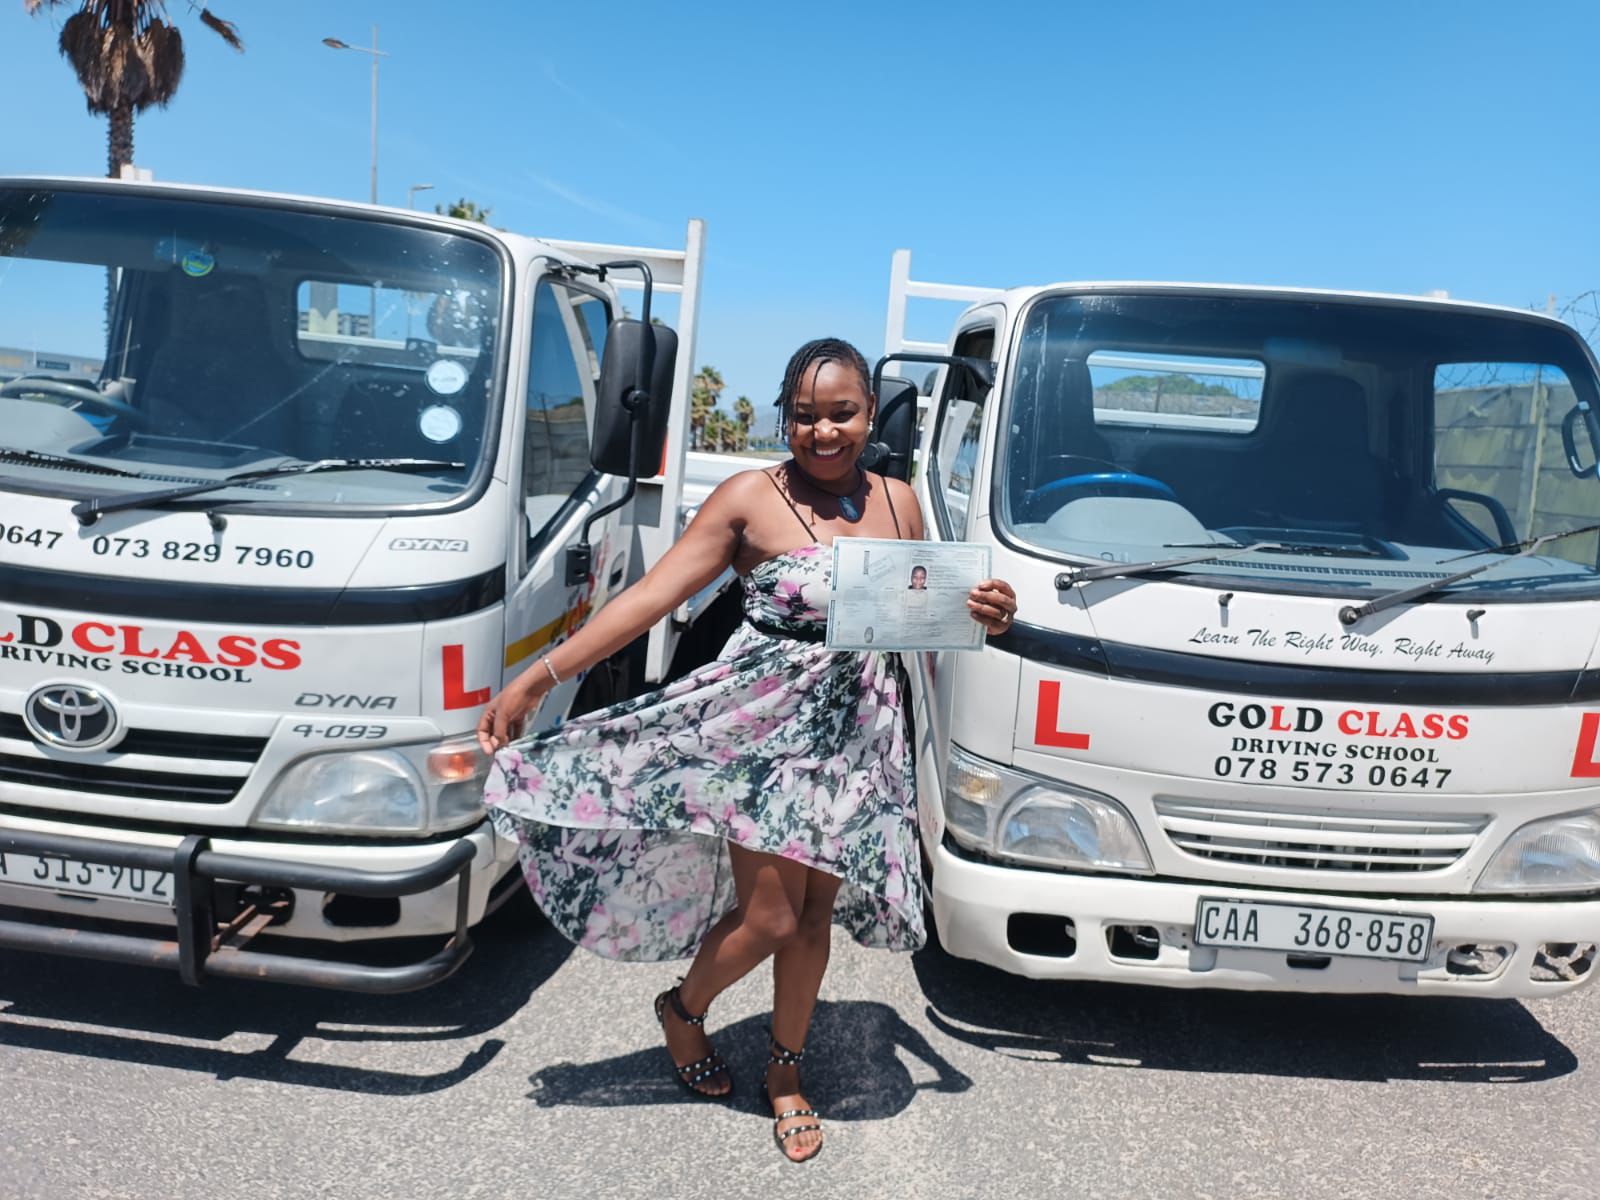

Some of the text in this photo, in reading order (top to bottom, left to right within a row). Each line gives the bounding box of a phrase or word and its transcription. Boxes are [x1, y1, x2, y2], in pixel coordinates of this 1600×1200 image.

[93, 536, 150, 558] 073
[162, 542, 221, 562] 829
[235, 546, 314, 569] 7960
[389, 538, 468, 552] DYNA
[72, 621, 302, 671] CLASS
[1188, 627, 1239, 645] Learn
[1247, 629, 1277, 647] The
[1284, 631, 1334, 655] Right
[1393, 637, 1443, 662] Right
[1446, 642, 1495, 665] Away
[121, 660, 252, 683] SCHOOL
[442, 644, 491, 711] L
[295, 693, 398, 710] DYNA
[1034, 680, 1090, 750] L
[1208, 702, 1469, 740] GOLD CLASS
[1231, 737, 1440, 763] DRIVING SCHOOL
[1570, 712, 1600, 778] L
[1214, 756, 1452, 789] 078 573 0647
[1204, 906, 1425, 956] CAA 368-858
